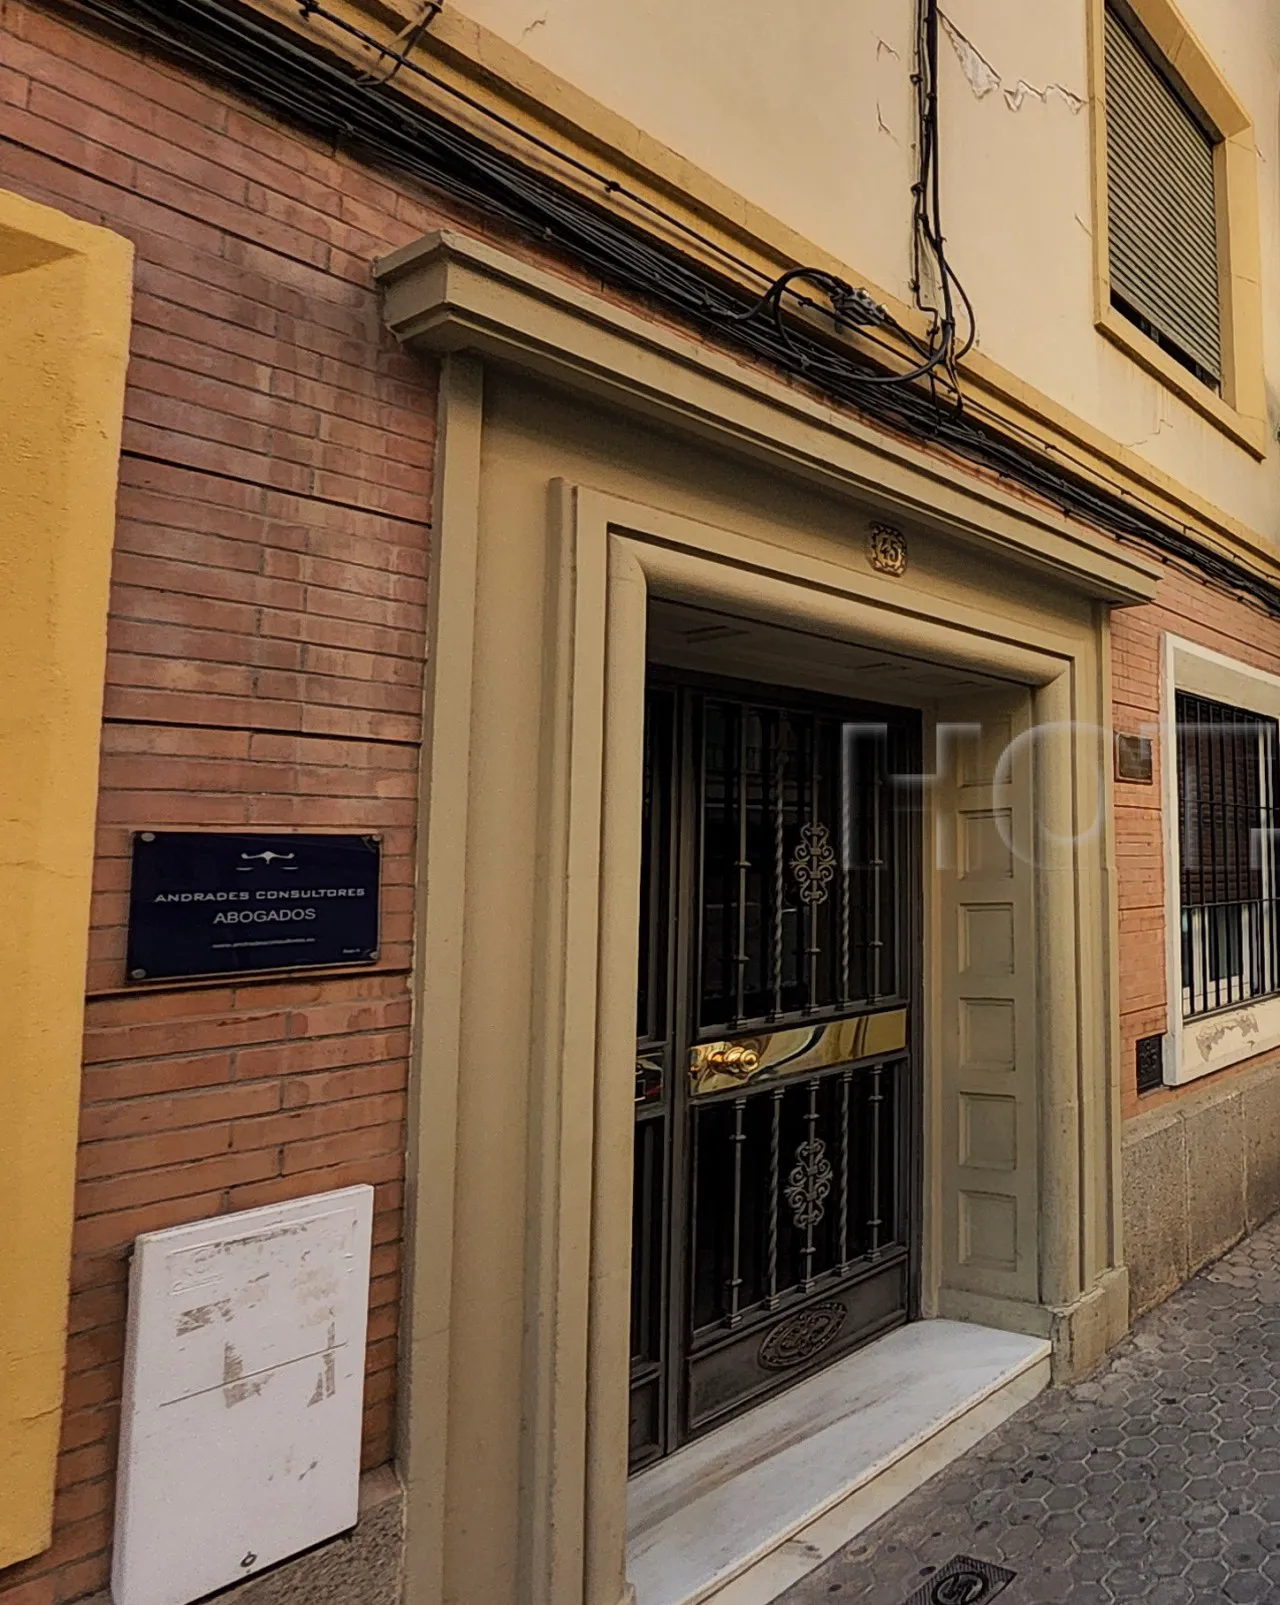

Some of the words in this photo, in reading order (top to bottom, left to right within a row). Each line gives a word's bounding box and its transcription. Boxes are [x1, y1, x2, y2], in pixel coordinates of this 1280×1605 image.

[880, 537, 899, 562] 45
[154, 891, 249, 902] ANDRADES
[255, 888, 365, 899] CONSULTORES
[213, 908, 316, 924] ABOGADOS
